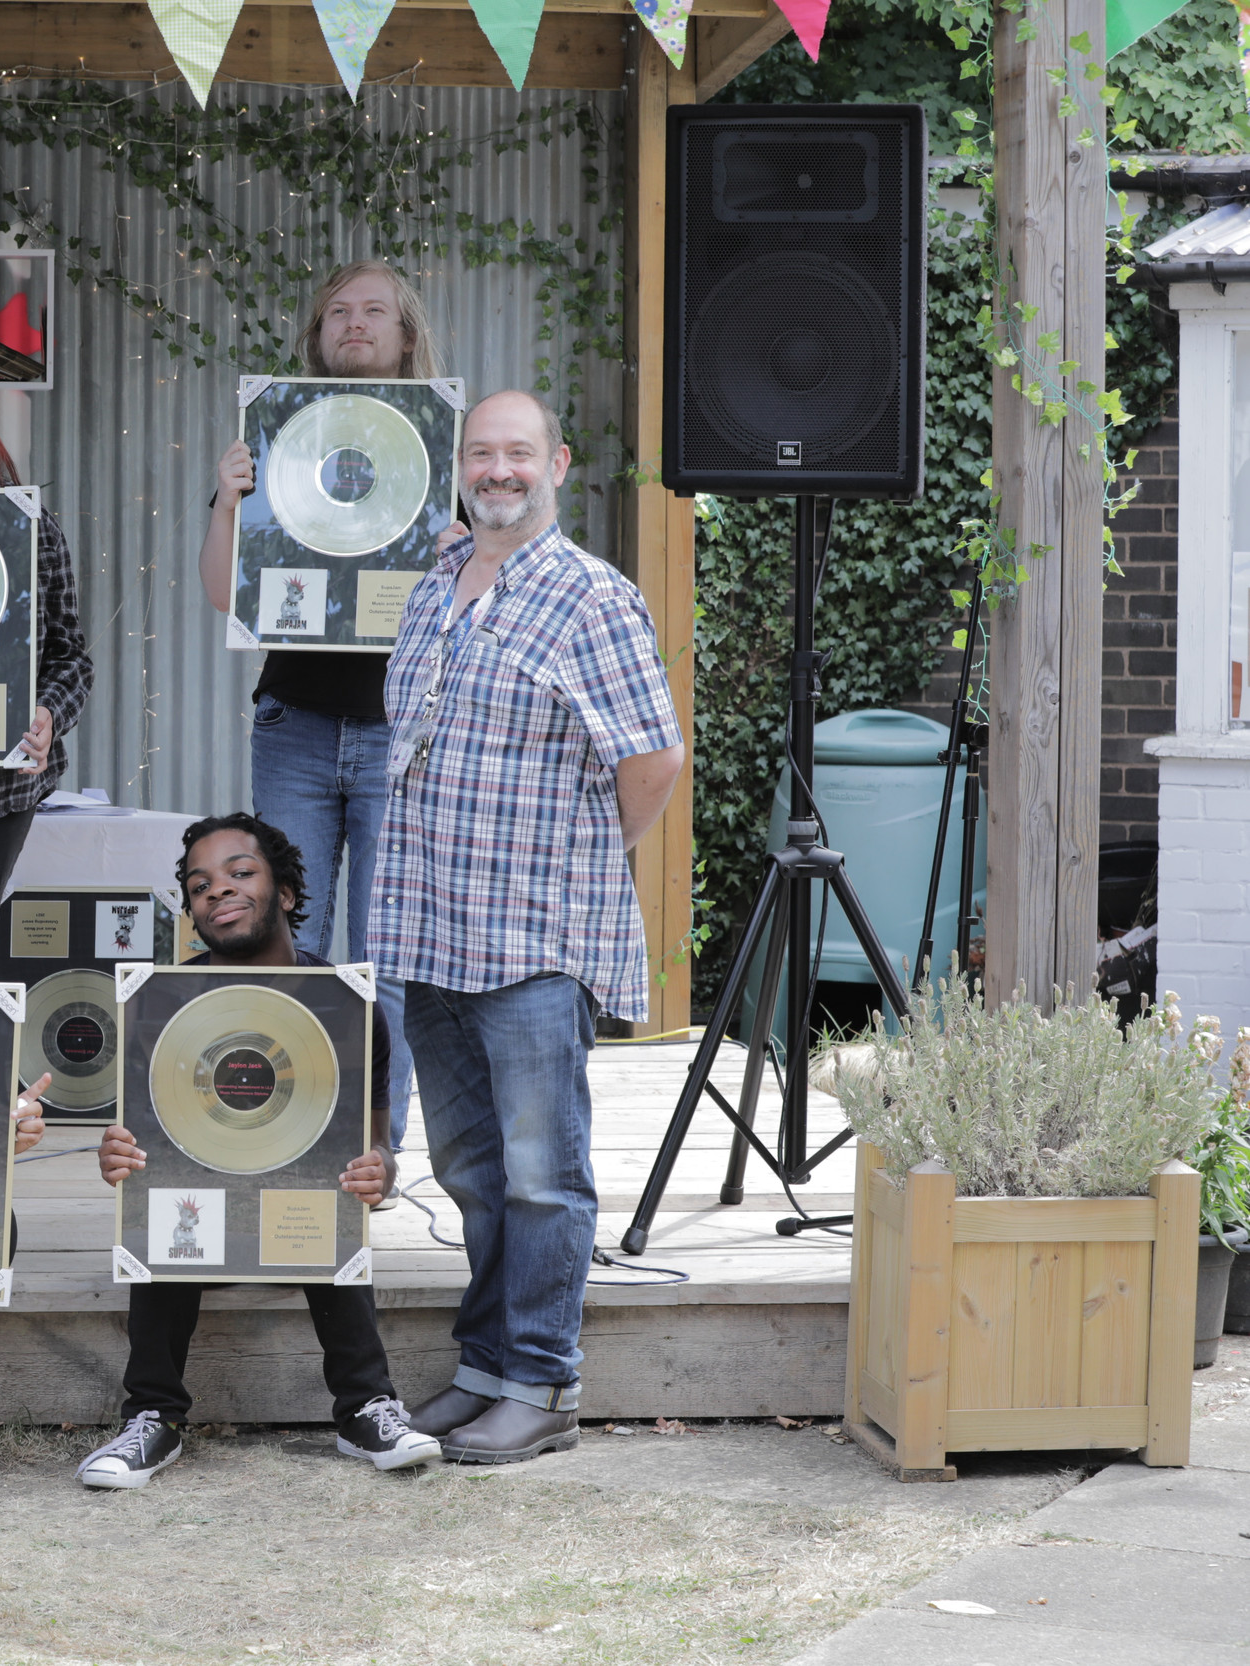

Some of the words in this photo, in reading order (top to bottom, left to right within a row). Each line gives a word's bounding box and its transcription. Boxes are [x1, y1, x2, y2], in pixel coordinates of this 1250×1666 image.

[782, 447, 796, 455] JBL
[276, 619, 306, 630] SUPAJAM
[456, 626, 466, 647] STAFF
[112, 906, 138, 914] SUPAJAM
[121, 970, 147, 998] nielsen
[342, 970, 367, 995] nielsen
[168, 1247, 203, 1259] SUPAJAM
[120, 1252, 146, 1278] nielsen
[340, 1253, 365, 1280] nielsen
